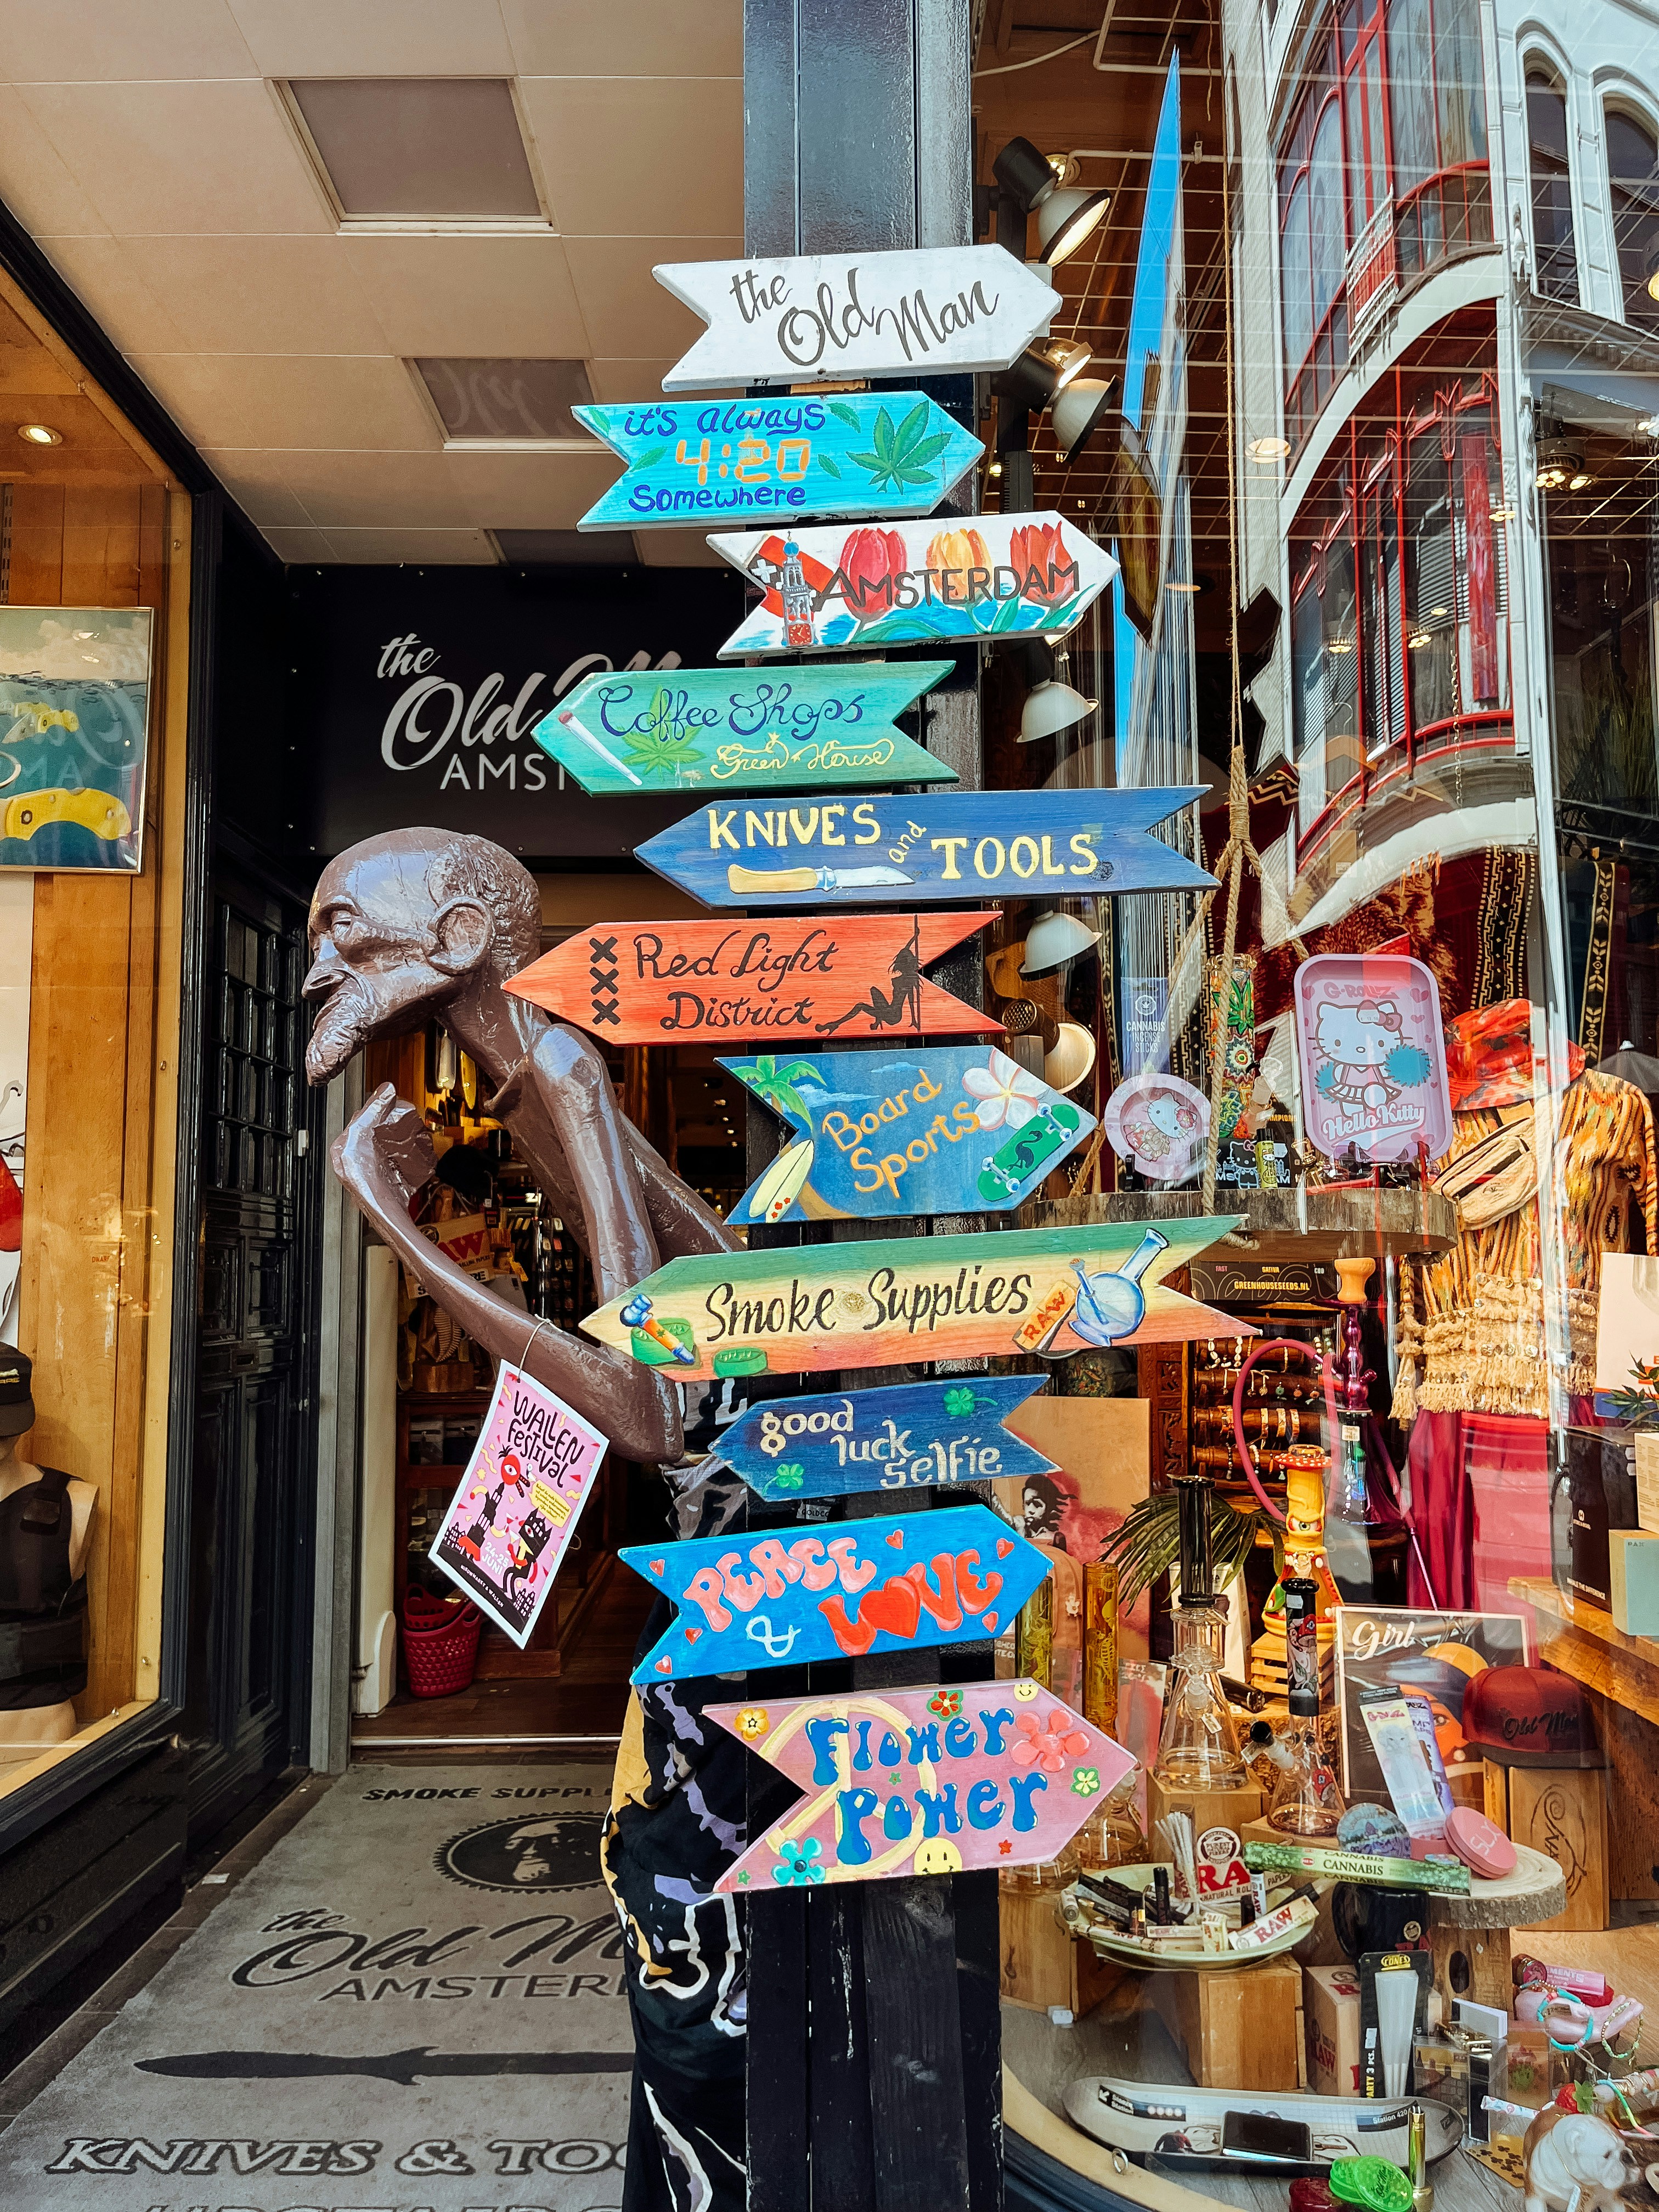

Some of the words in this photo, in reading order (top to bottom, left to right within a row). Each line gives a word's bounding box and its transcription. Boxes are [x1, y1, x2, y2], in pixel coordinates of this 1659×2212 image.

[730, 269, 793, 324] the
[777, 267, 877, 366] Old
[876, 280, 1000, 362] Man
[625, 406, 678, 437] it's
[697, 402, 826, 436] always
[676, 437, 811, 485] 4:20
[629, 484, 806, 512] Somewhere
[812, 561, 1080, 612] AMSTERDAM
[377, 633, 441, 678] the
[381, 672, 547, 770] Old
[599, 685, 725, 742] Coffee
[729, 683, 866, 741] Shops
[710, 740, 790, 780] Green
[791, 738, 895, 770] House
[707, 803, 882, 849] KNIVES
[888, 821, 928, 864] and
[930, 833, 1101, 880] TOOLS
[634, 929, 743, 979] Red
[730, 929, 839, 992] Light
[660, 991, 816, 1030] District
[1126, 1021, 1165, 1031] CANNABIS
[1132, 1032, 1161, 1042] INCENSE
[1135, 1042, 1159, 1053] STICKS
[822, 1069, 944, 1151] Board
[1323, 1111, 1379, 1141] Hello
[1376, 1103, 1425, 1127] Kitty
[851, 1102, 982, 1198] Sports
[706, 1279, 838, 1342] Smoke
[862, 1266, 1033, 1335] Supplies
[1234, 1280, 1310, 1291] GREENHOUSESEEDS.NL
[1021, 1289, 1069, 1341] RAW
[514, 1390, 585, 1465] WALLEN
[760, 1399, 855, 1457] good
[832, 1420, 916, 1465] luck
[879, 1435, 1002, 1489] selfie
[482, 1554, 503, 1575] JUNI
[684, 1537, 877, 1633] PEACE
[746, 1615, 801, 1658] &
[1352, 1620, 1415, 1661] Girl
[805, 1707, 1015, 1786] Flower
[1503, 1716, 1538, 1741] Old
[362, 1787, 483, 1801] SMOKE
[836, 1772, 1048, 1865] Power
[1198, 1860, 1251, 1894] RA
[1323, 1859, 1383, 1875] CANNABIS
[1324, 1851, 1384, 1862] CANNABIS
[261, 1908, 352, 1933] the
[1254, 1906, 1294, 1944] RAW
[230, 1926, 485, 1988] Old
[318, 1974, 628, 2001] AMSTER
[1372, 2114, 1396, 2124] Station
[1397, 2109, 1408, 2118] 420
[46, 2136, 382, 2176] KNIVES
[394, 2140, 477, 2176] &
[488, 2138, 628, 2176] TO
